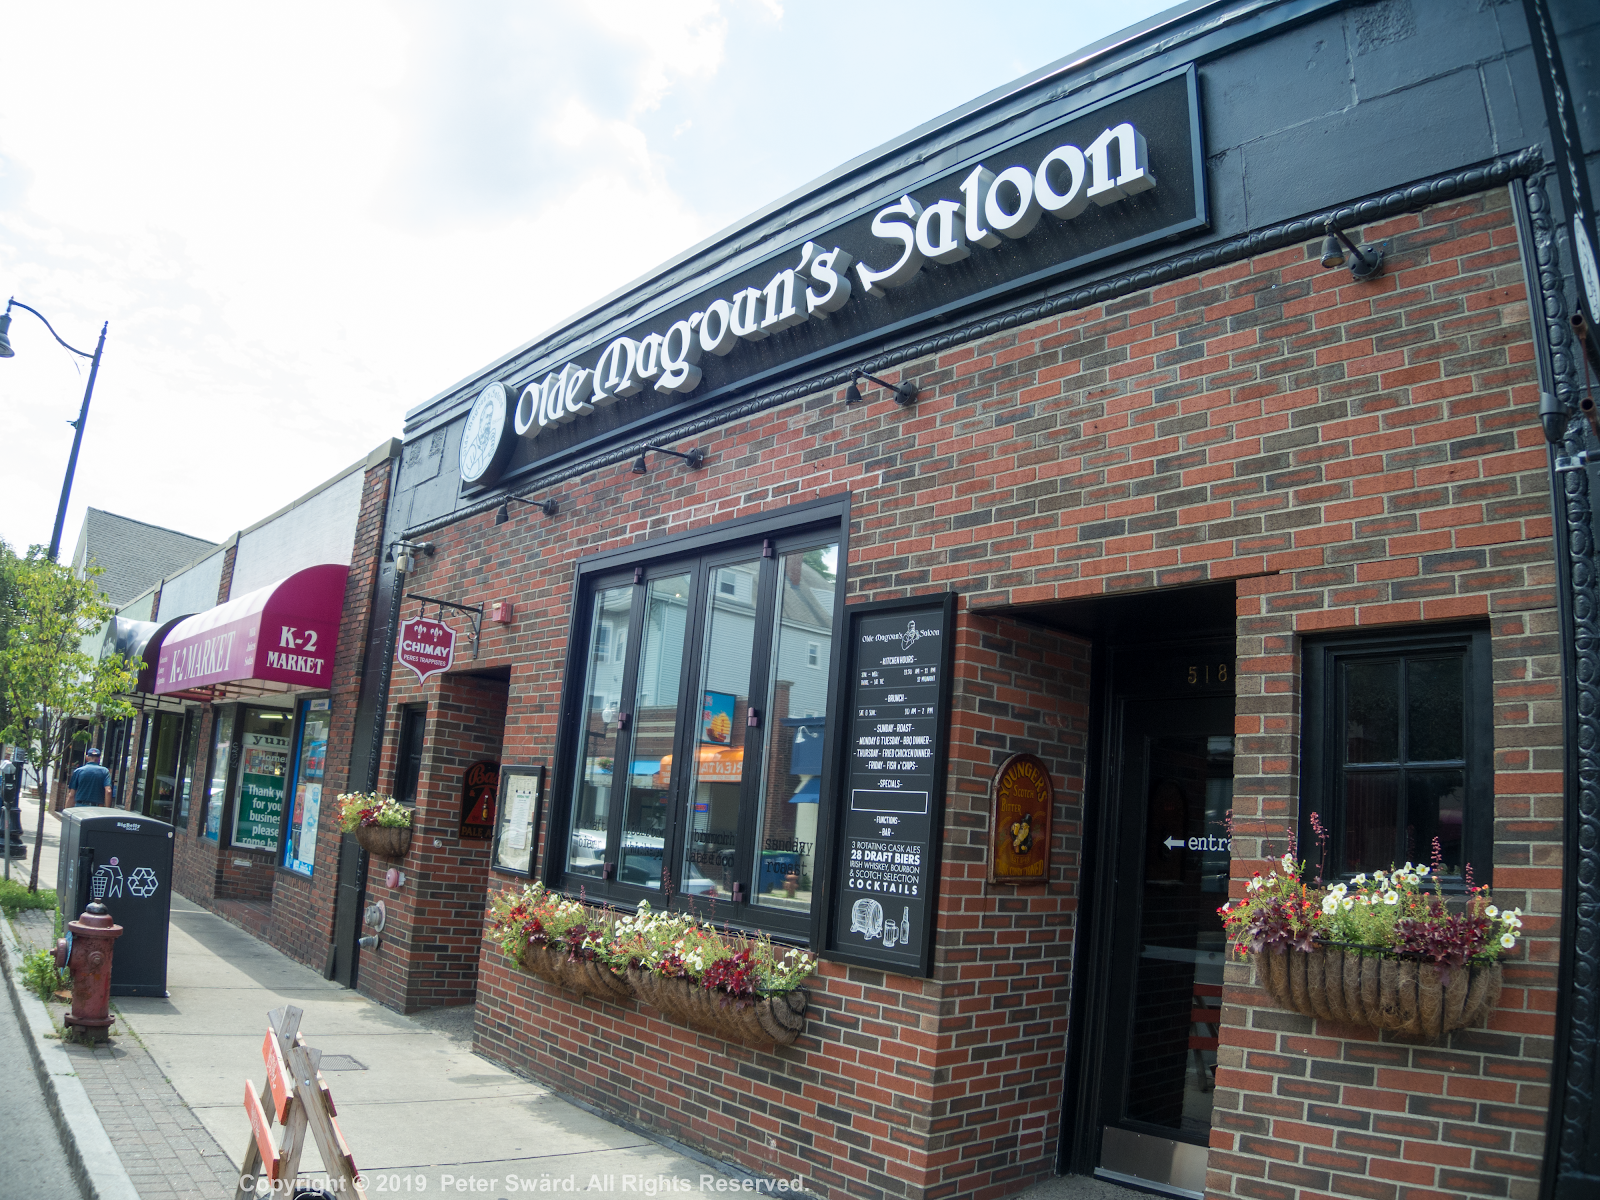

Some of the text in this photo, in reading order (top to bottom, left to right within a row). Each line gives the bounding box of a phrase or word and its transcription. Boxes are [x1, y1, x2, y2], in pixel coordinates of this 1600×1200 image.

[514, 122, 1147, 435] Olde Magoun's Saloon
[279, 626, 318, 652] K-2
[862, 634, 874, 642] Olde
[920, 629, 940, 638] Saloon
[402, 640, 450, 658] CHIMAY
[169, 631, 236, 684] K-2 MARKET
[266, 651, 324, 675] MARKET
[420, 656, 446, 667] TRAPPISTES
[1188, 664, 1227, 684] 518
[258, 752, 287, 763] Home
[882, 749, 895, 757] FRIED
[895, 749, 914, 757] CHICKEN
[261, 763, 274, 771] Ice
[886, 761, 897, 770] FISH
[248, 784, 274, 797] Thank
[252, 797, 282, 812] for you
[249, 810, 281, 824] busines
[252, 824, 279, 837] please
[461, 826, 483, 836] PALE
[857, 841, 887, 851] ROTATING
[888, 844, 905, 852] CASK
[906, 845, 921, 854] ALES
[851, 849, 920, 865] 28 DRAFT BIERS
[864, 861, 890, 872] WHISKEY,
[891, 864, 920, 874] BOURBON
[850, 869, 919, 884] & SCOTCH SELECTION
[849, 879, 918, 895] COCKTAILS
